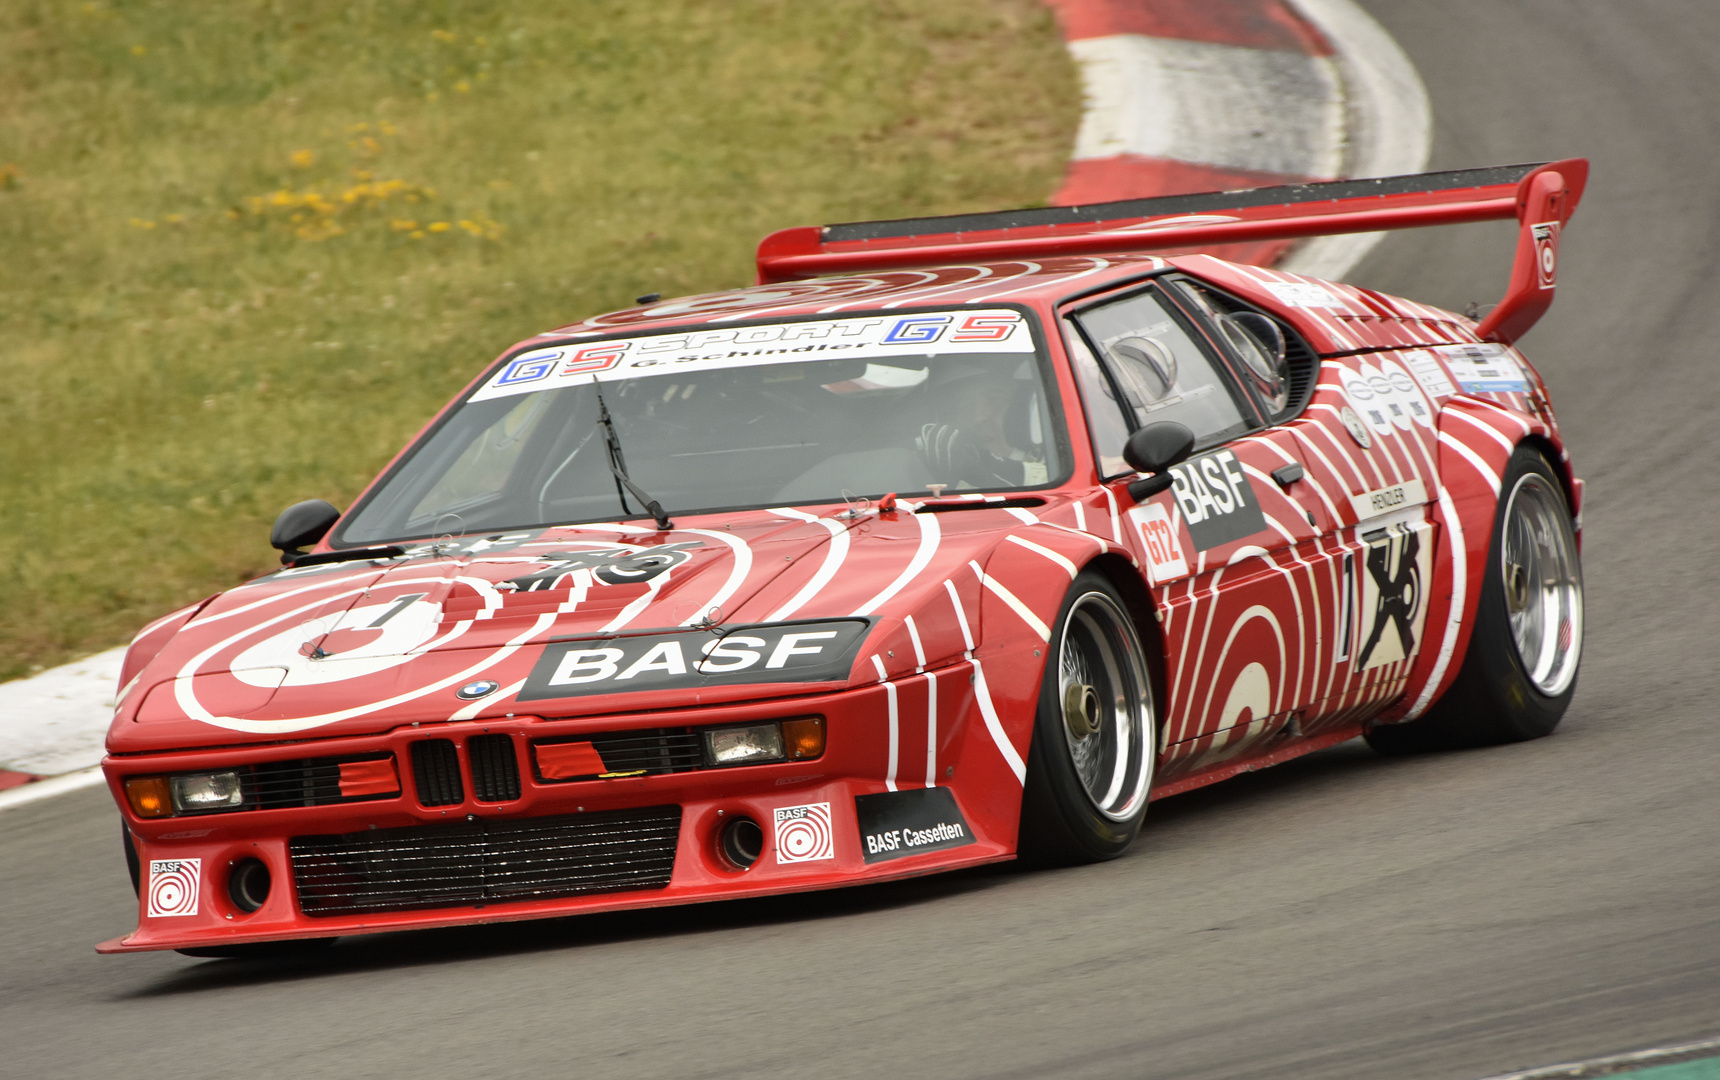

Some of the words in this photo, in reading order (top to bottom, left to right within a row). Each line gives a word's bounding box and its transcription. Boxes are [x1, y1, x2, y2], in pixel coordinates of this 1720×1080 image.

[636, 320, 883, 354] SPORT
[631, 359, 667, 368] G.
[675, 342, 873, 363] Schindler
[1168, 450, 1246, 525] BASF
[1141, 519, 1181, 566] GT2
[548, 630, 838, 686] BASF
[777, 808, 807, 821] BASF
[867, 831, 901, 854] BASF
[903, 822, 964, 847] Cassetten
[152, 862, 181, 873] BASF
